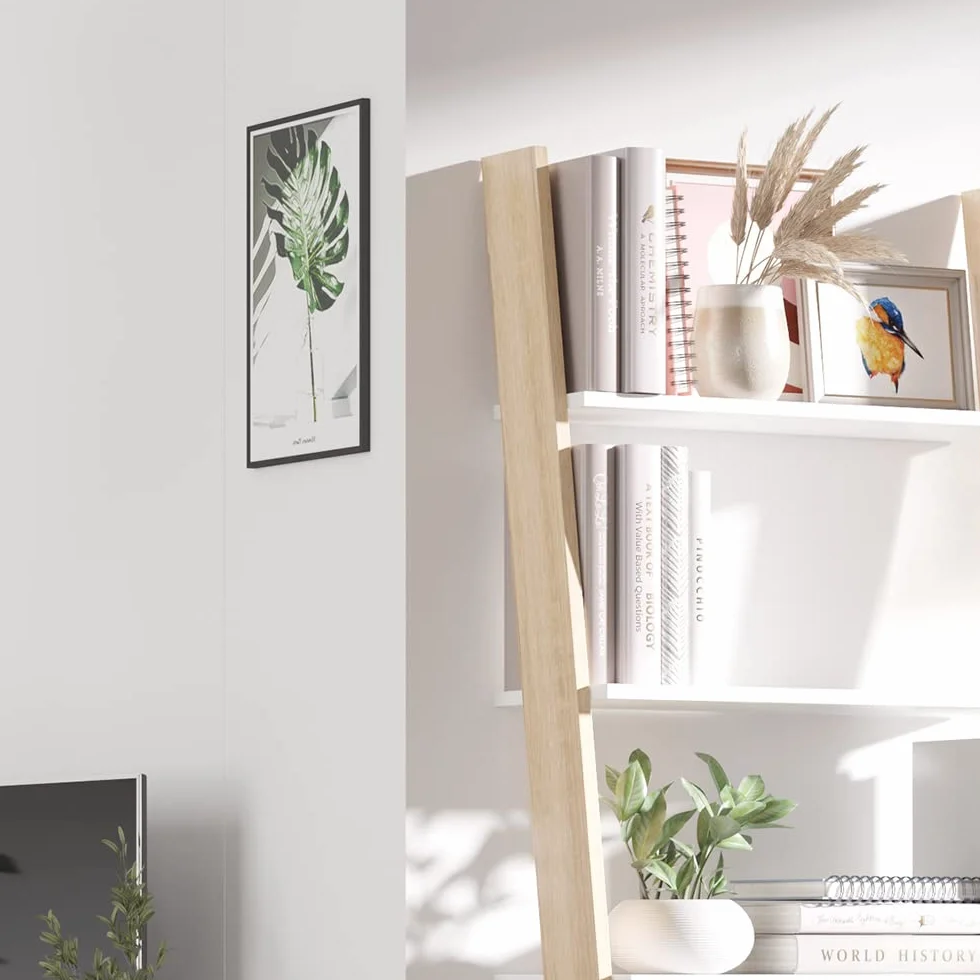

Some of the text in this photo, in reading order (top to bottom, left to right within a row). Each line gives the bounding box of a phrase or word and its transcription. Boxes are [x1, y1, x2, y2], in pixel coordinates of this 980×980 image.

[595, 267, 605, 297] MILNE
[648, 231, 658, 338] CHEMISTRY
[634, 501, 643, 633] With Value Based Questions
[695, 537, 705, 623] PINOCCHIO
[645, 592, 656, 652] BIOLOGY
[820, 946, 977, 963] WORLD HISTORY
